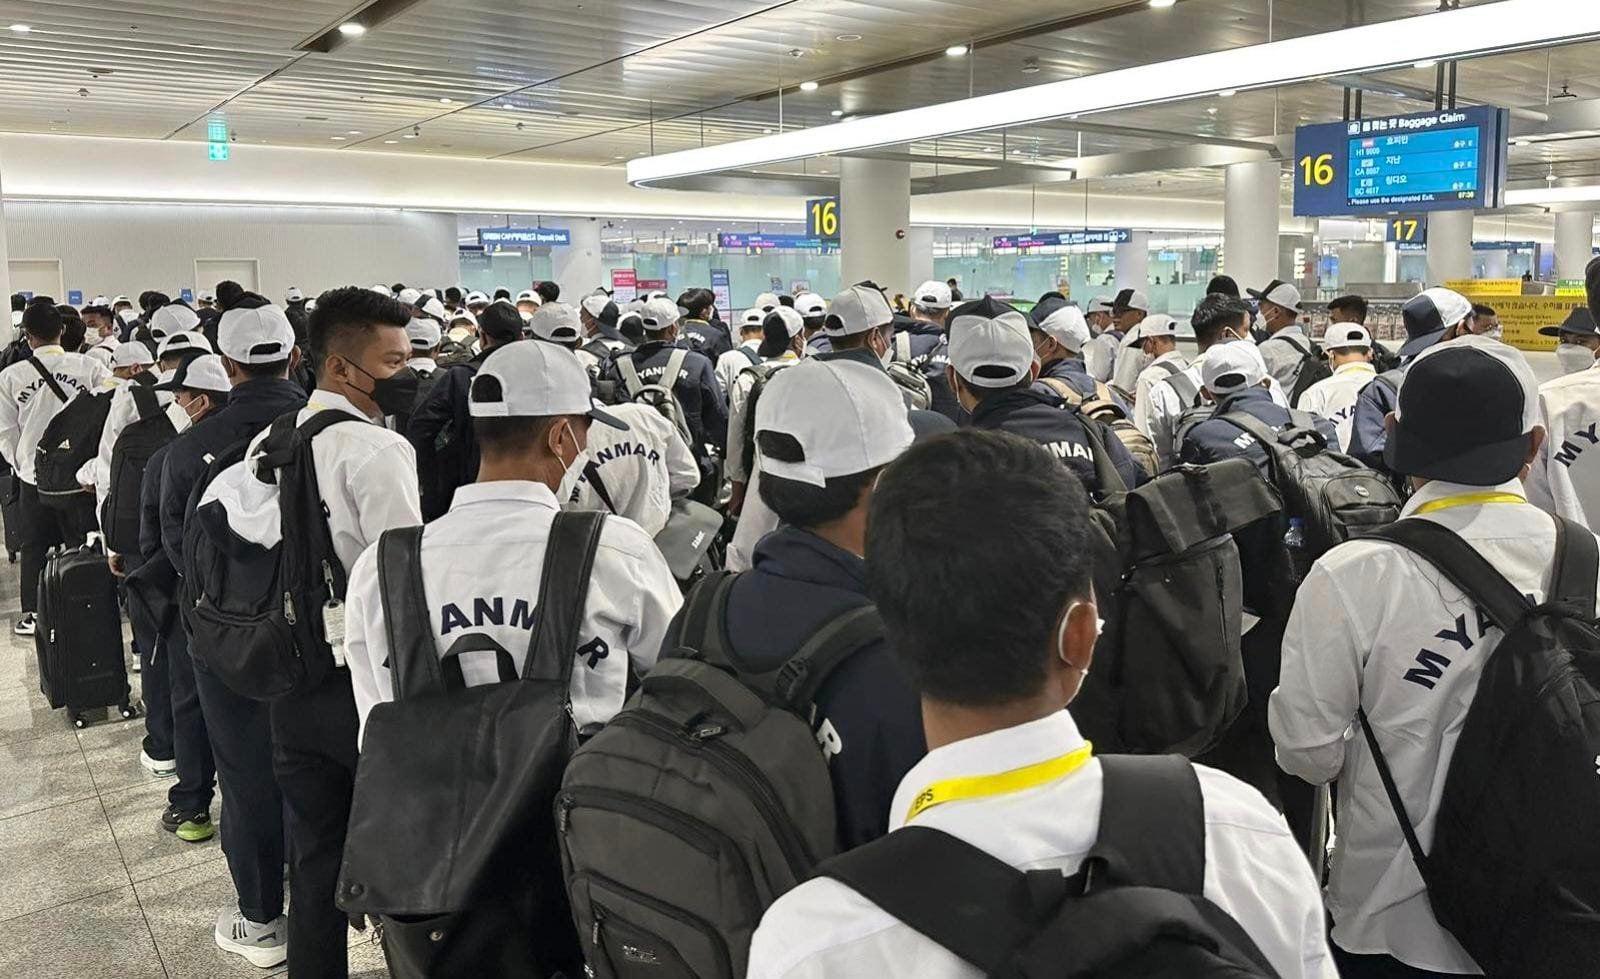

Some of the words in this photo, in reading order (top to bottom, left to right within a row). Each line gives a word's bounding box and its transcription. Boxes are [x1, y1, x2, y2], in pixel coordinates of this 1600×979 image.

[1398, 116, 1438, 129] Baggage
[1439, 112, 1466, 124] Claim
[1299, 153, 1334, 186] 16
[1351, 198, 1369, 206] Please
[1390, 195, 1421, 204] designated
[812, 201, 838, 235] 16
[1392, 219, 1418, 241] 17
[1403, 594, 1536, 690] MYA
